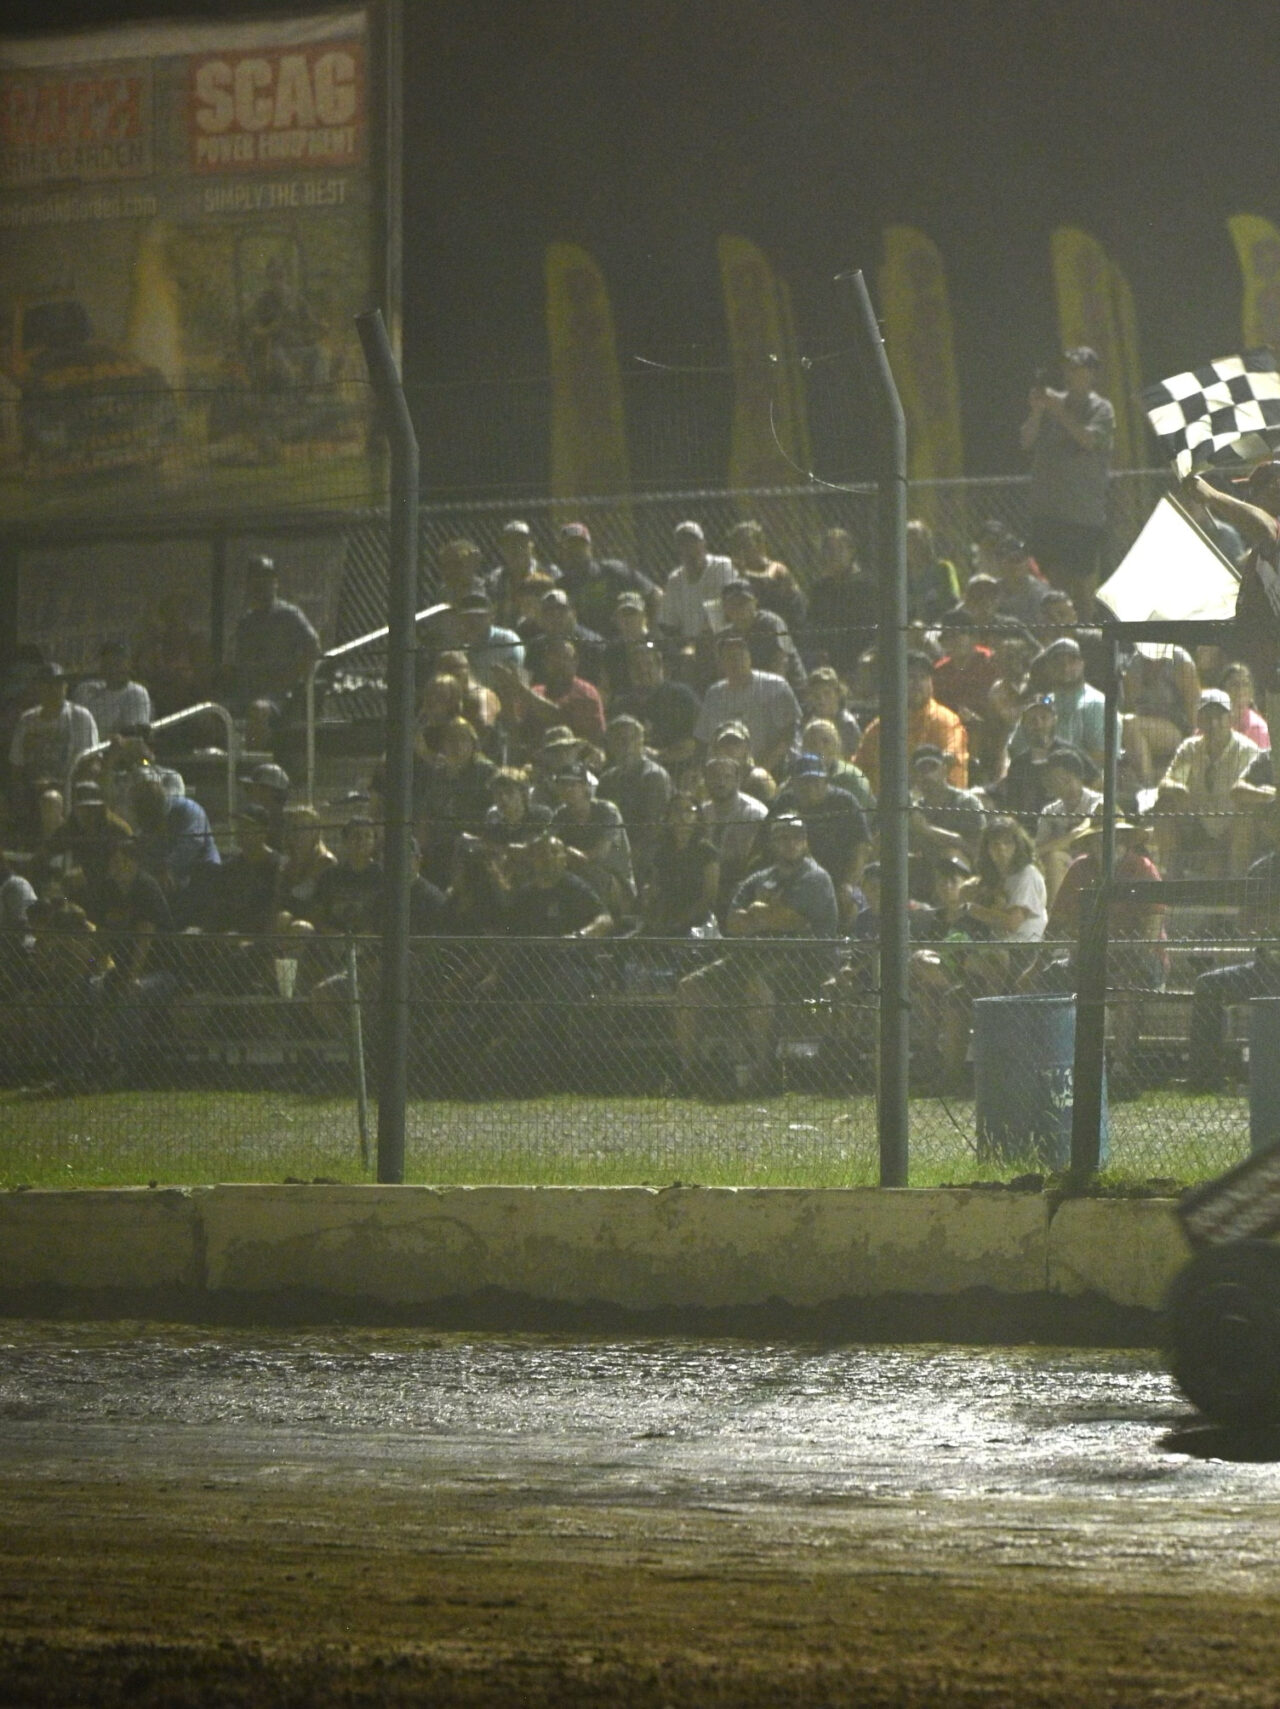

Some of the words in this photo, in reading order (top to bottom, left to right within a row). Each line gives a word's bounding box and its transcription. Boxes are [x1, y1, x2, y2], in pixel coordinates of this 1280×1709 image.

[196, 51, 356, 133] SCAG
[198, 133, 254, 163] POWER
[259, 128, 356, 160] EQUIPMENT
[205, 184, 264, 212] SIMPLY
[270, 182, 300, 207] THE
[305, 179, 350, 206] BEST
